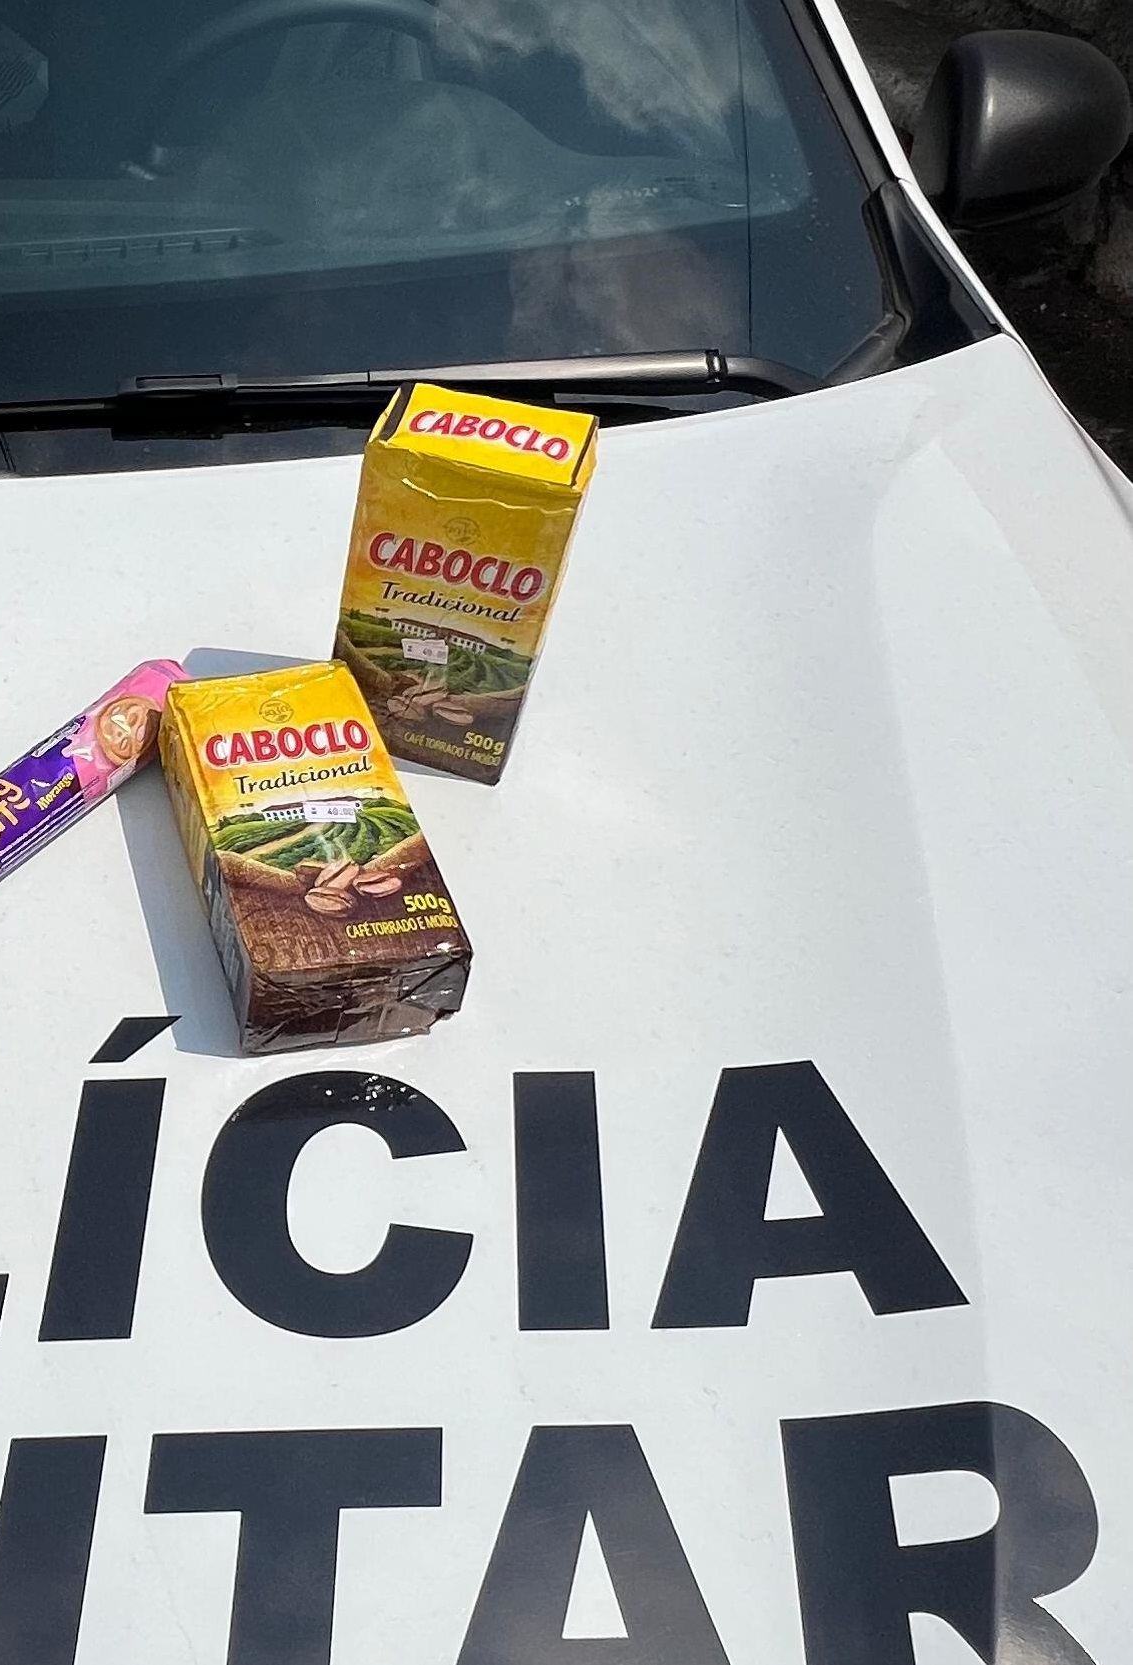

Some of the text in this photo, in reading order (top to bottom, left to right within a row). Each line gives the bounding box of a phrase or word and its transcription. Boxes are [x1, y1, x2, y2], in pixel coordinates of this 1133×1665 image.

[409, 410, 570, 461] CABOCLO
[368, 532, 544, 601] CABOCLO
[381, 581, 523, 623] Tradicional
[206, 719, 369, 766] CABOCLO
[404, 731, 426, 747] CAFÉ
[464, 748, 471, 760] E
[463, 731, 505, 755] 500g
[35, 772, 75, 811] Morango
[233, 755, 372, 795] Tradicional
[403, 893, 452, 914] 500g
[346, 921, 372, 939] CAFÉ
[371, 917, 418, 936] TORRADO
[417, 916, 426, 930] E
